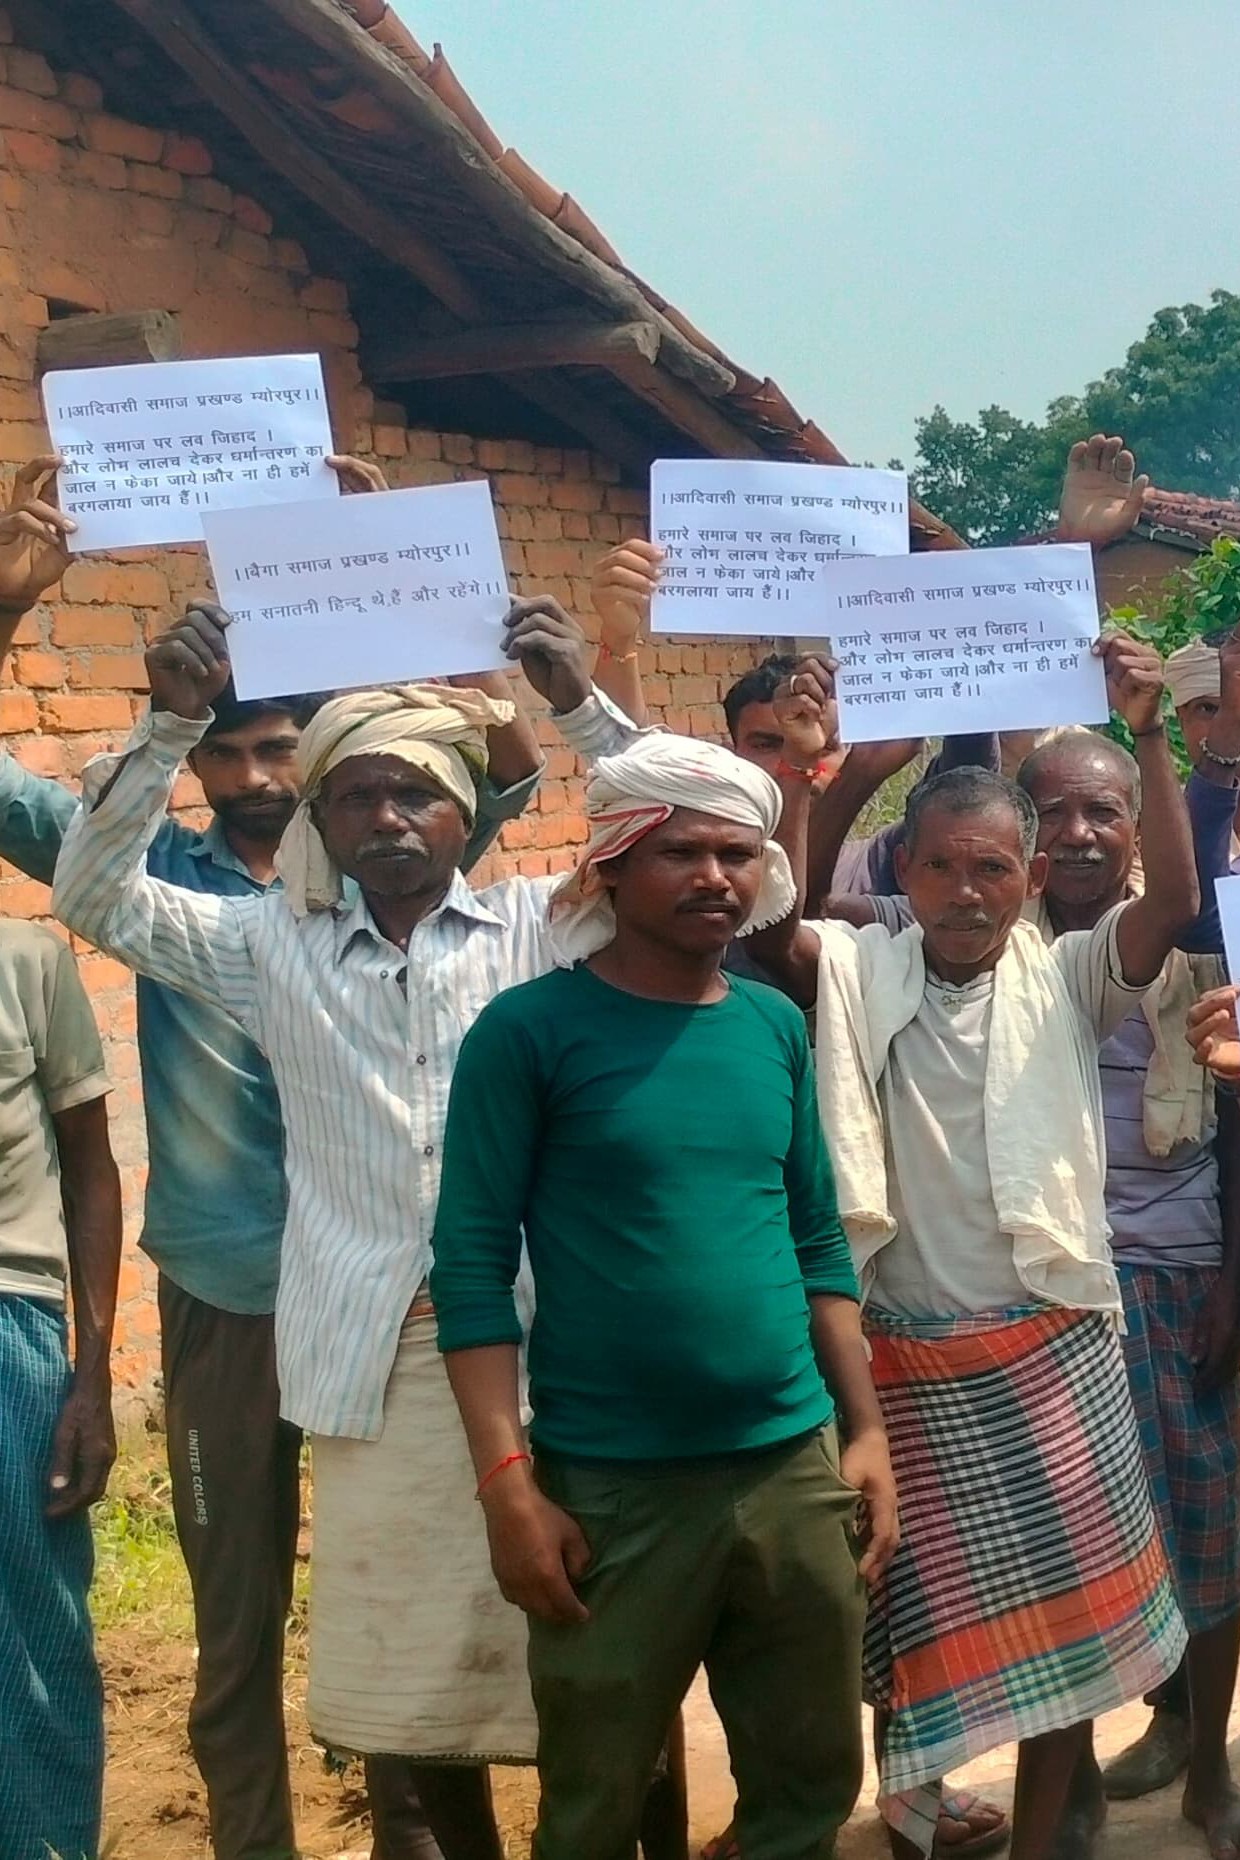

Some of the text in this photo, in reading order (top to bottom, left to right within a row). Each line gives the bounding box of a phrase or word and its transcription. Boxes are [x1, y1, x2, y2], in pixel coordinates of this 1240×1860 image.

[59, 387, 319, 419] ।।आदिवासी समाज प्रखण्ड म्योरपुर।।
[102, 440, 145, 453] समाज
[152, 437, 172, 449] पर
[179, 435, 203, 447] लव
[211, 430, 256, 445] जिहाद
[58, 459, 89, 474] और
[136, 456, 181, 470] लालच
[188, 450, 223, 466] देकर
[230, 446, 297, 462] धर्मान्तरण
[304, 445, 324, 457] का
[64, 481, 96, 494] जाल
[124, 474, 158, 489] फेका
[166, 470, 197, 486] जाये
[241, 469, 258, 480] ना
[266, 464, 281, 479] ही
[289, 461, 310, 478] हमें
[66, 495, 170, 513] बरगलाया जाय
[662, 489, 903, 515] ।।आदिवासी समाज प्रखण्ड म्योरपुर।।
[658, 526, 841, 546] हमारे समाज पर लव जिहाद
[235, 543, 470, 581] ।।बैगा समाज प्रखण्ड म्योरपुर।।
[726, 549, 768, 562] लालच
[775, 547, 807, 563] देकर
[714, 564, 745, 580] फेका
[752, 565, 781, 580] जाये
[261, 599, 319, 619] सनातनी
[328, 596, 367, 613] हिन्दू
[412, 585, 439, 601] और
[726, 587, 754, 598] जाय
[838, 577, 1089, 608] ।।आदिवासी समाज प्रखण्ड म्योरपुर।।
[838, 621, 1028, 648] हमारे समाज पर लव जिहाद
[838, 651, 866, 668] और
[912, 648, 954, 662] लालच
[962, 642, 995, 658] देकर
[1002, 637, 1066, 654] धर्मान्तरण
[842, 673, 873, 686] जाल
[899, 666, 933, 681] फेका
[939, 662, 969, 678] जाये
[1012, 661, 1028, 672] ना
[1035, 656, 1050, 672] ही
[1057, 653, 1079, 670] हमें
[843, 690, 906, 706] बरगलाया
[914, 687, 943, 699] जाय
[188, 1429, 208, 1525] UNITED COLORS
